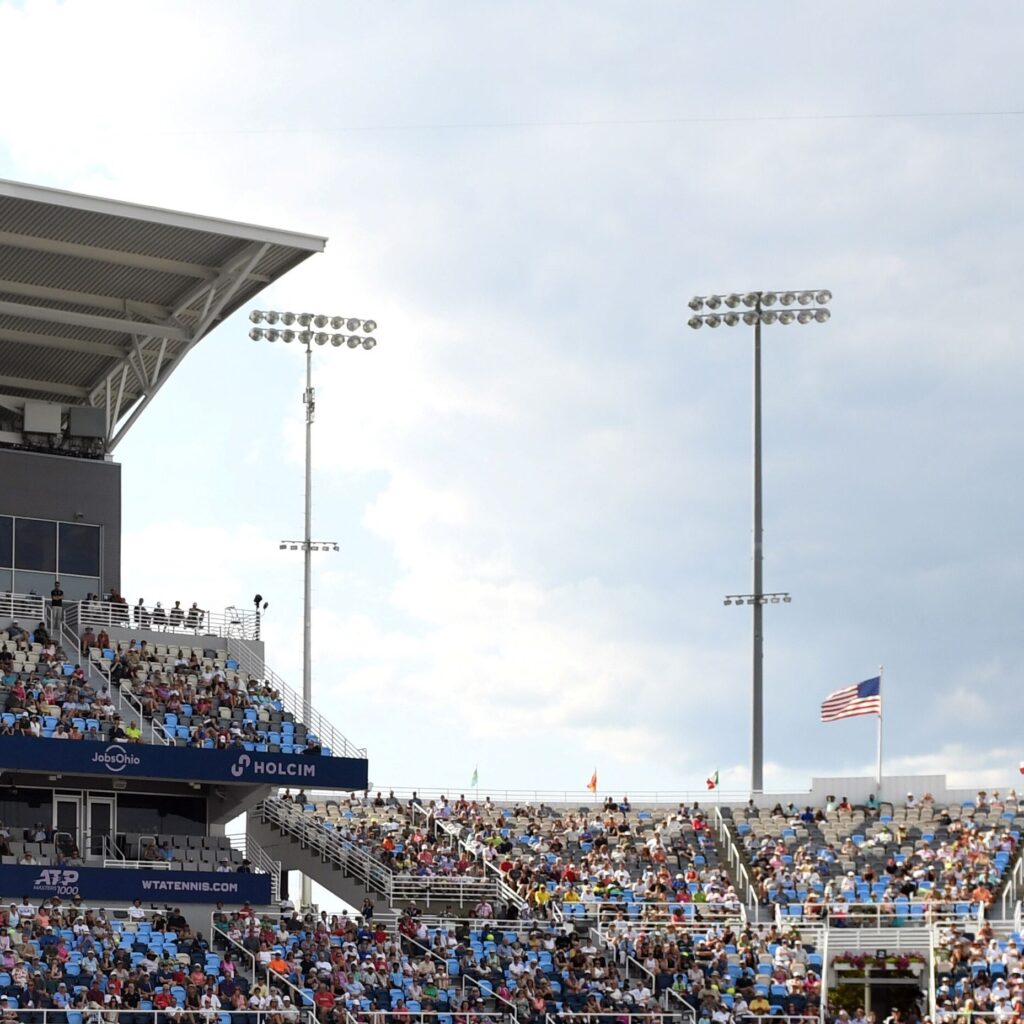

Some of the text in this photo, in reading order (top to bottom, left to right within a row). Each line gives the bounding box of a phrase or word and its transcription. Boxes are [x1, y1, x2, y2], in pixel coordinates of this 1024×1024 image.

[91, 751, 141, 765] JobsOhio
[254, 761, 316, 777] HOLCIM
[33, 869, 79, 886] ATP
[57, 886, 79, 895] 1000
[142, 879, 238, 893] WTATENNIS.COM
